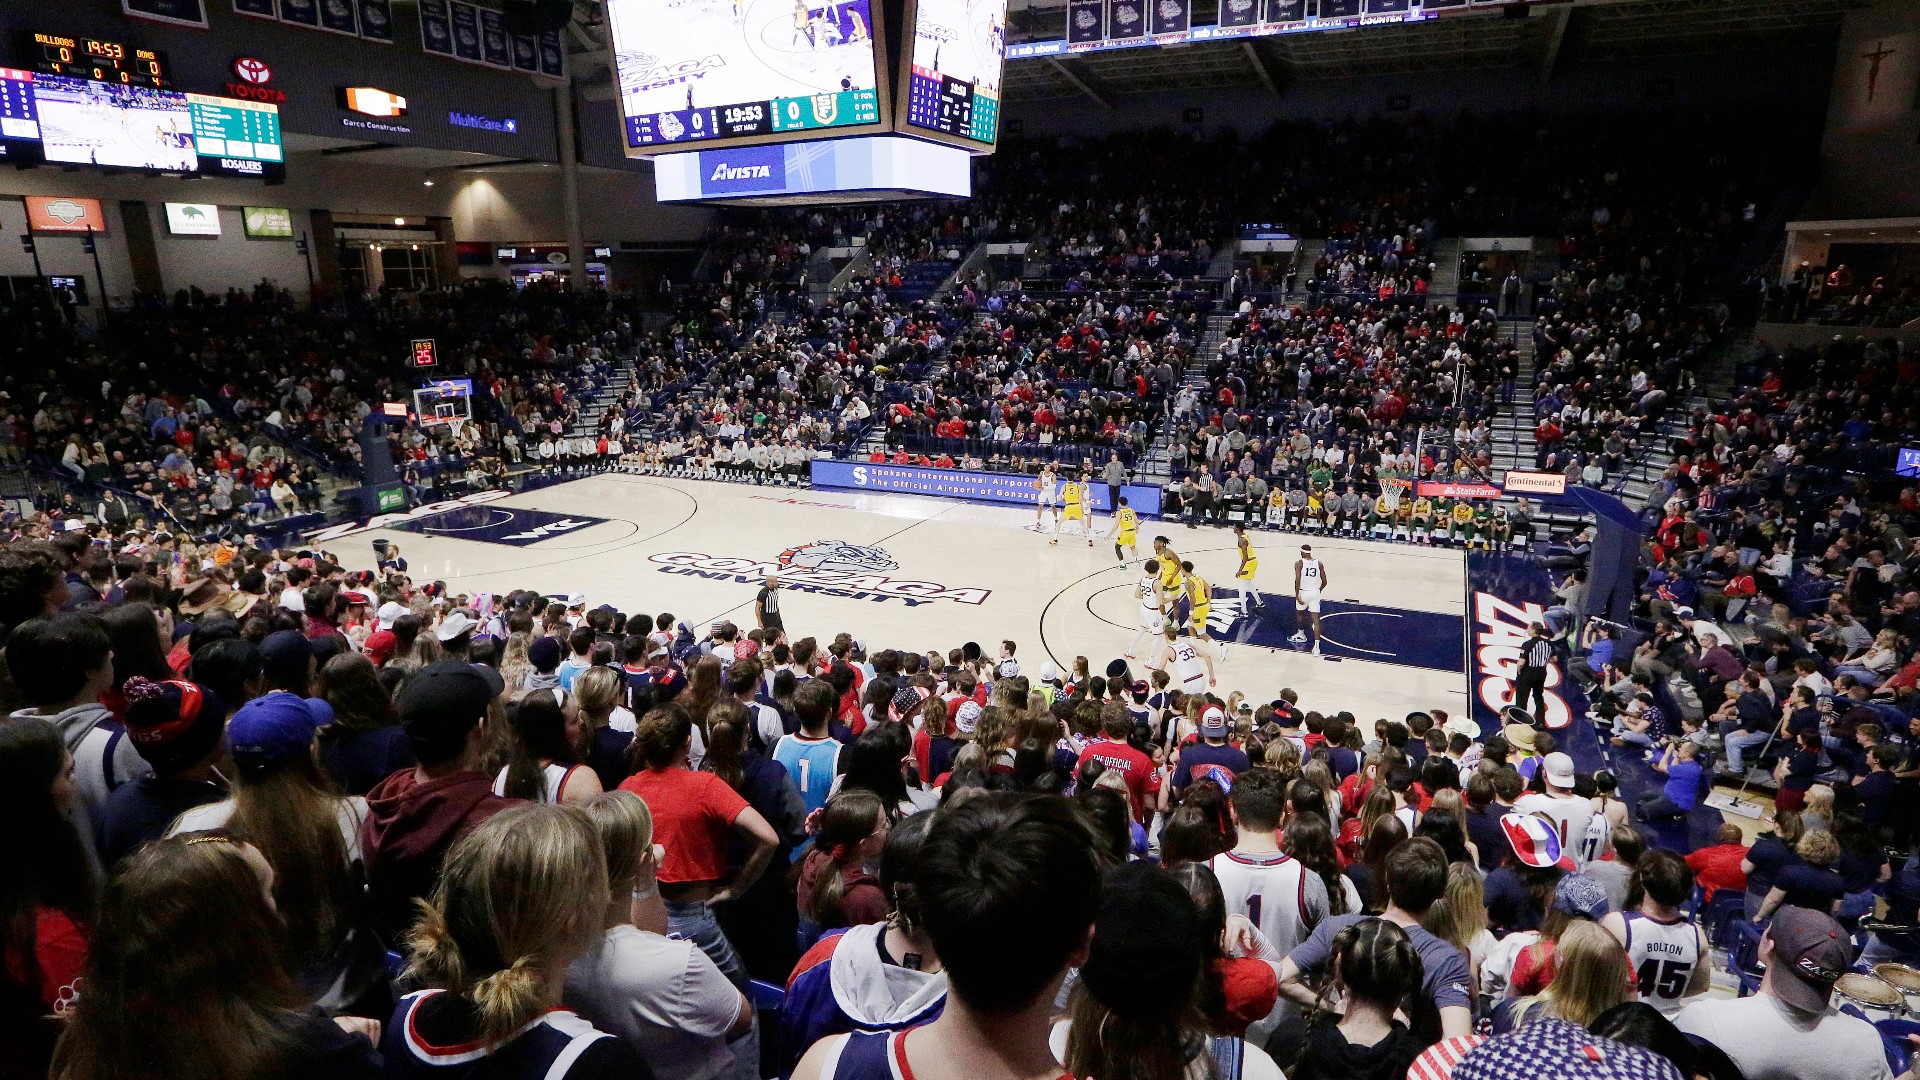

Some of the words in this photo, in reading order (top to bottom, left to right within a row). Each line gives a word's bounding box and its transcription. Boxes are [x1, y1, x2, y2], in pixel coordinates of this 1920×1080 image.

[34, 33, 75, 48] BULLDOGS
[87, 40, 123, 58] 19:53
[136, 50, 155, 60] DONS
[60, 47, 70, 62] 0
[52, 62, 61, 72] 4
[94, 68, 102, 79] 0
[121, 72, 129, 82] 0
[150, 62, 159, 75] 0
[226, 82, 287, 103] TOYOTA
[725, 106, 762, 123] 19:53
[788, 102, 799, 120] 0
[343, 118, 365, 128] Garco
[367, 122, 410, 133] Construction
[450, 112, 500, 130] MultiCare
[692, 112, 702, 130] 0
[221, 158, 262, 170] ROSAUERS
[711, 164, 770, 180] AVISTA
[416, 350, 432, 364] 25
[872, 468, 913, 478] Spokane
[918, 472, 987, 484] International
[992, 478, 1033, 488] Airport
[1508, 476, 1555, 487] Continental
[872, 478, 888, 487] The
[893, 480, 932, 490] Official
[937, 484, 975, 494] Airport
[997, 490, 1040, 501] Gonzag
[1124, 513, 1132, 522] 55
[648, 552, 992, 605] GONZAGA
[1305, 568, 1317, 577] 13
[657, 566, 935, 607] UNIVERSITY
[1141, 585, 1151, 597] 22
[1179, 647, 1196, 661] 33
[1474, 591, 1572, 729] ZAGS
[1105, 757, 1131, 770] OFFICIAL
[798, 758, 810, 792] 1
[1247, 894, 1262, 929] 1
[1647, 942, 1683, 956] BOLTON
[1800, 958, 1839, 979] ZAGS
[1637, 958, 1691, 999] 45
